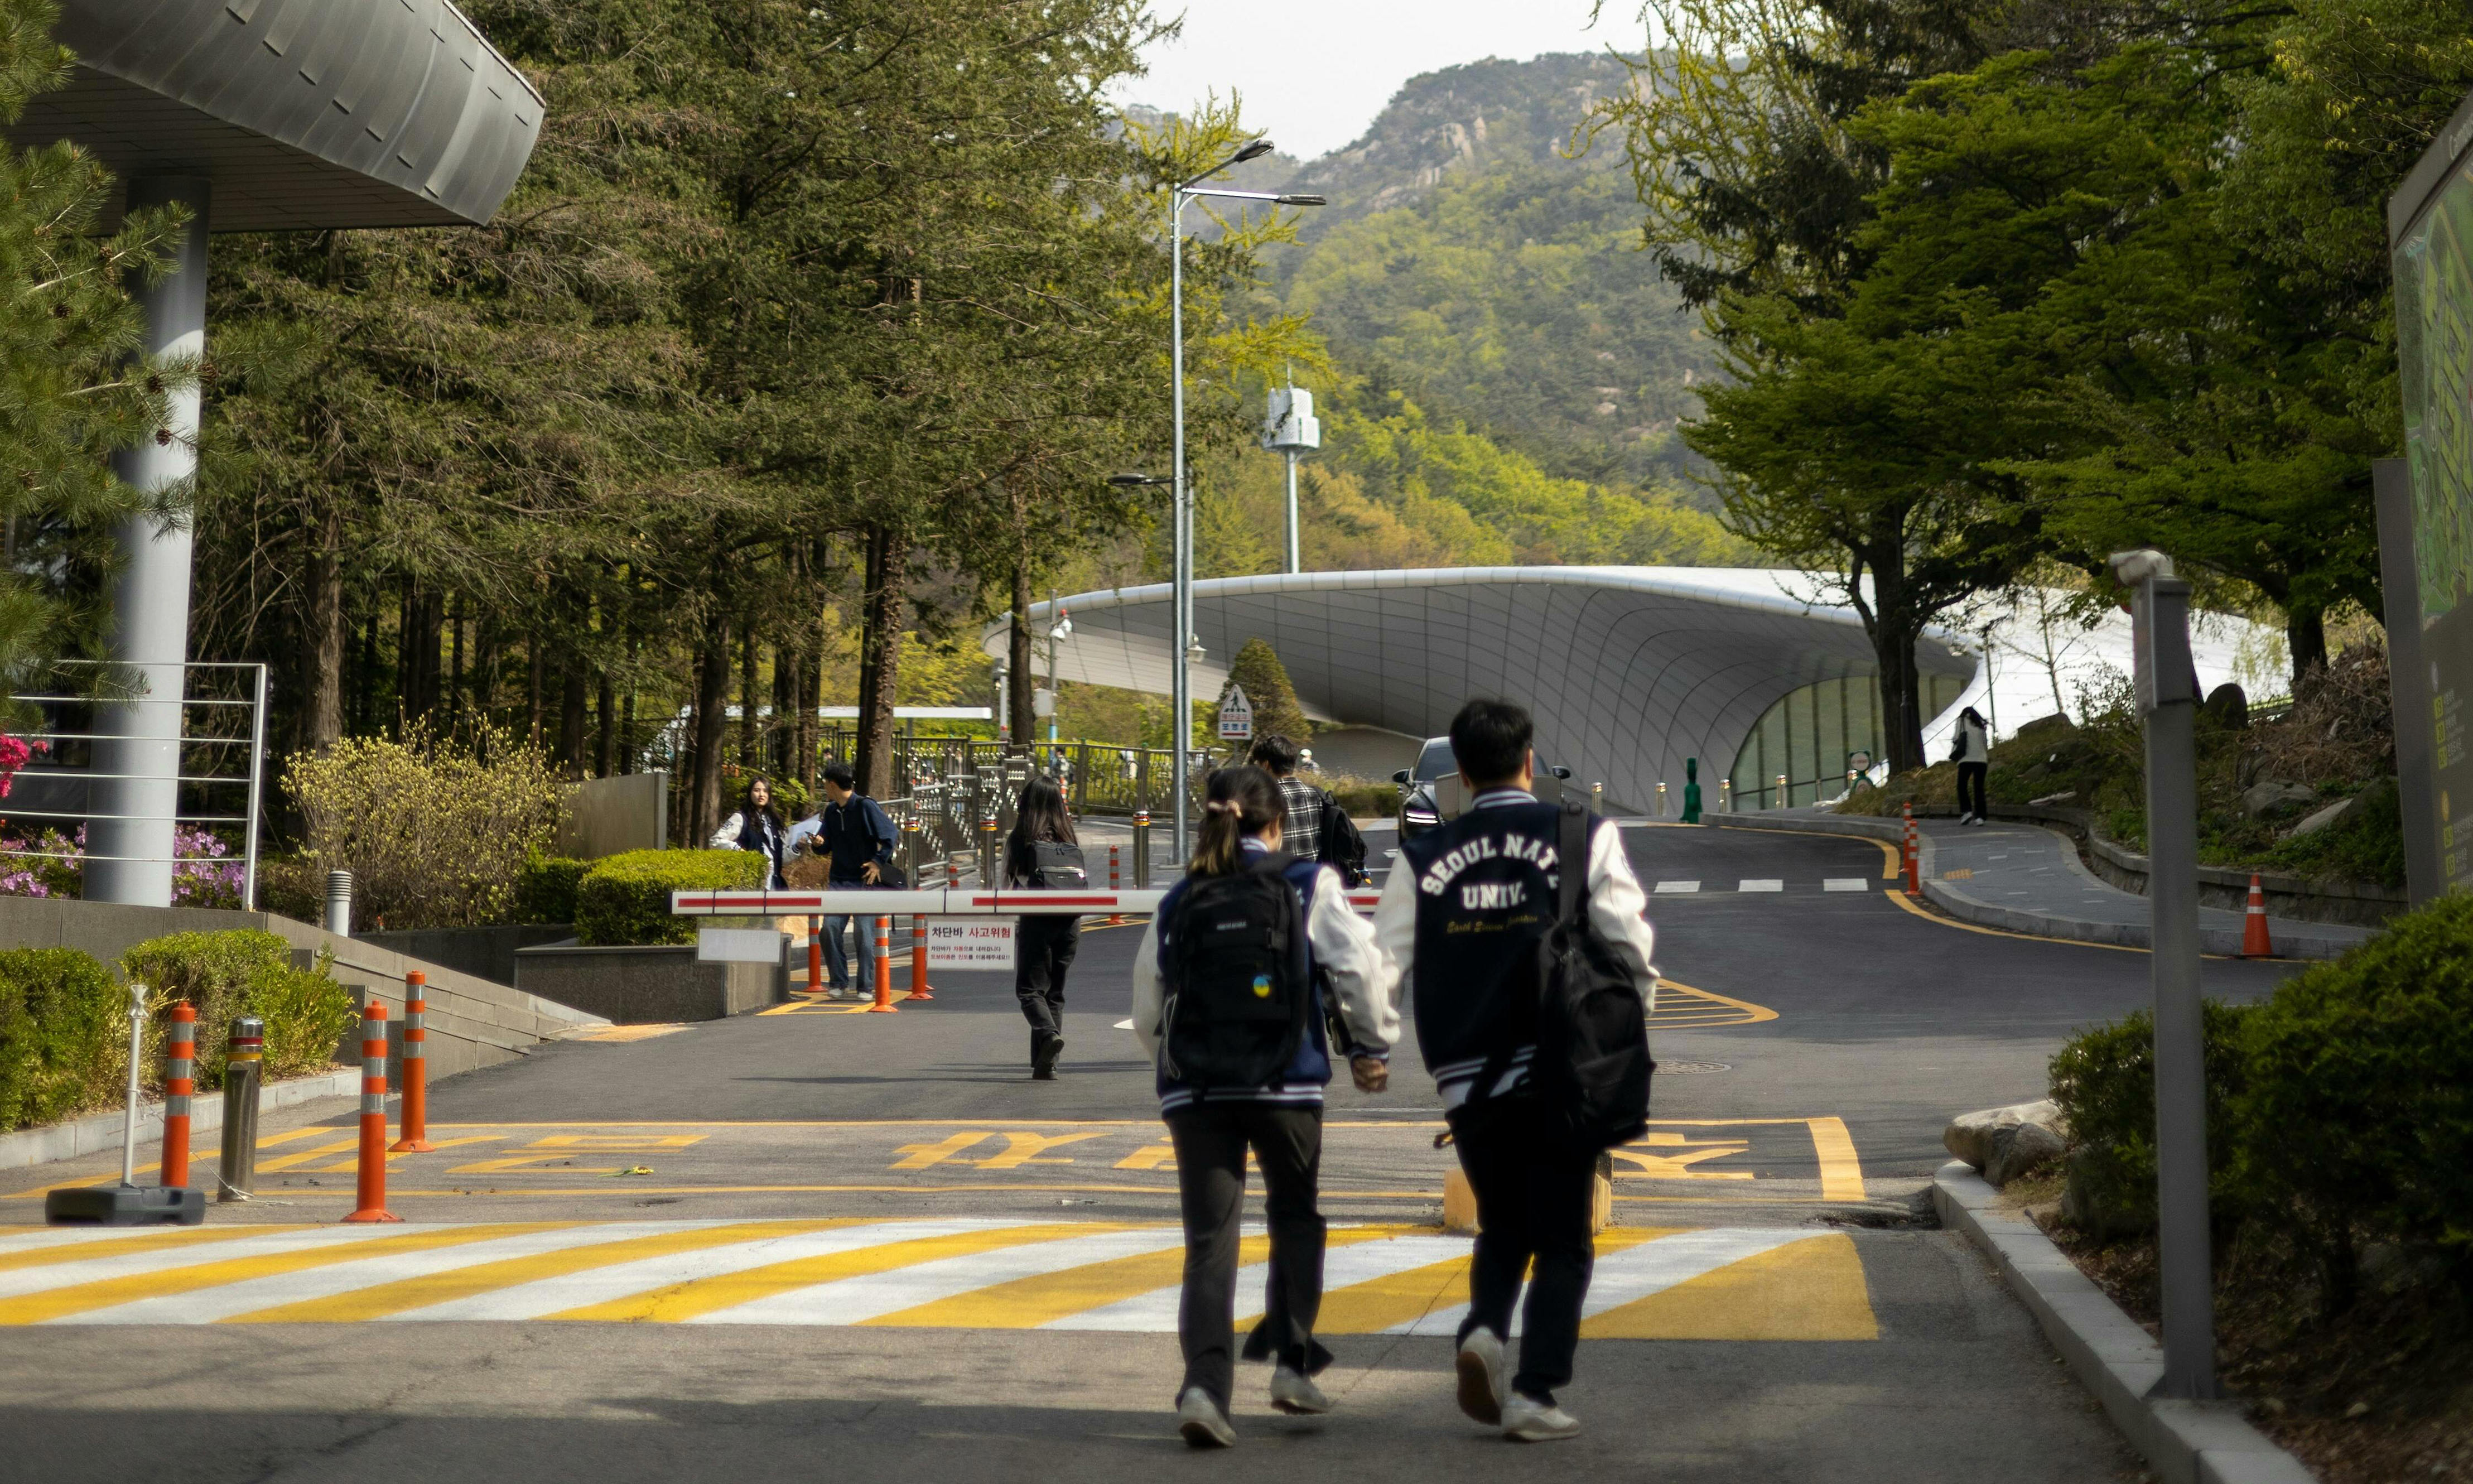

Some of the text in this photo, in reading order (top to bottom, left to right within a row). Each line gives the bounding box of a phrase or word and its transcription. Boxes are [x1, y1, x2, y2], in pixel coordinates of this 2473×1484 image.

[1421, 833, 1559, 895] SEOUL NATL
[1462, 881, 1527, 909] UNIV.
[932, 927, 1010, 938] 차단바 사고위험
